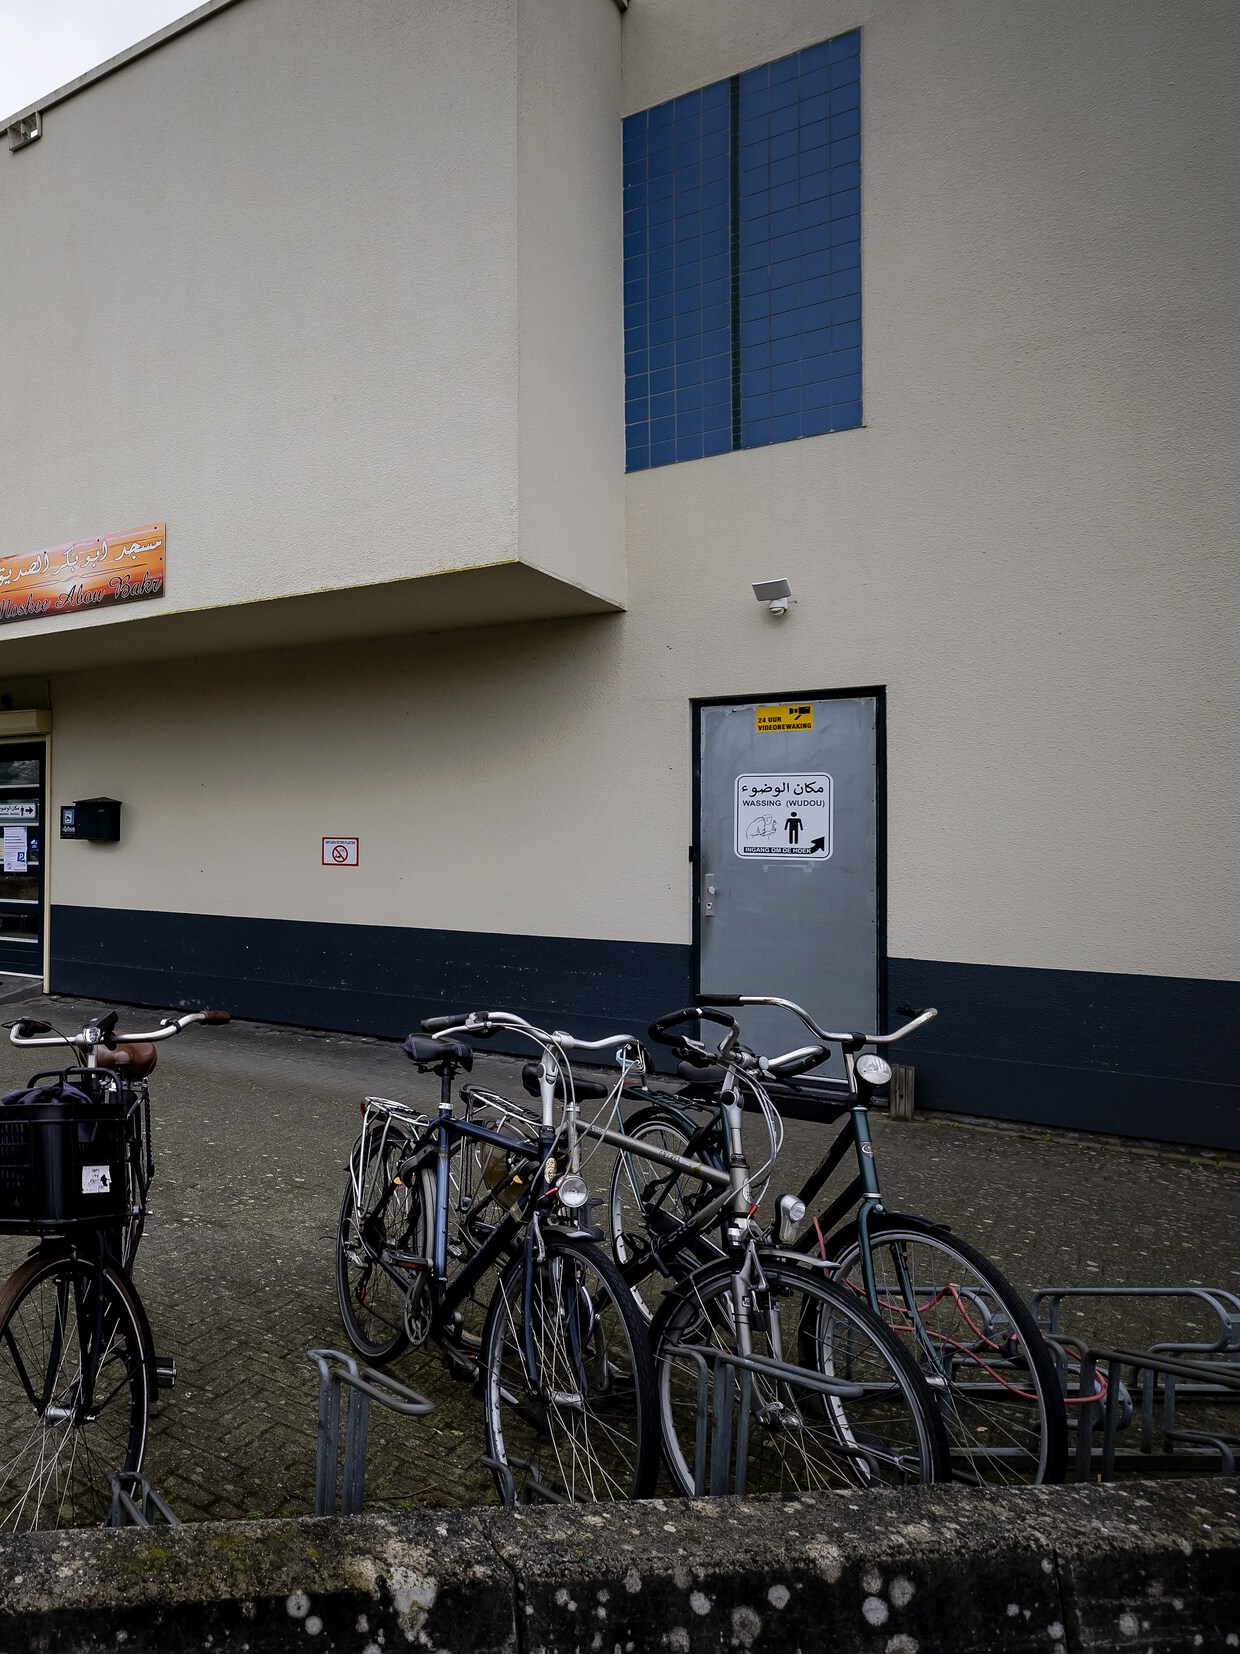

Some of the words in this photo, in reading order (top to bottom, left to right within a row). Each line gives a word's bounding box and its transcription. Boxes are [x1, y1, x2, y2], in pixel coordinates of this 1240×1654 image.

[113, 539, 162, 561] مسجد
[55, 583, 106, 608] Abou
[108, 569, 163, 599] Bakr
[757, 722, 812, 731] VIDEOBEWAKING
[741, 781, 790, 798] الوضوء
[793, 780, 825, 796] مكان
[785, 799, 826, 808] (WUDOU)
